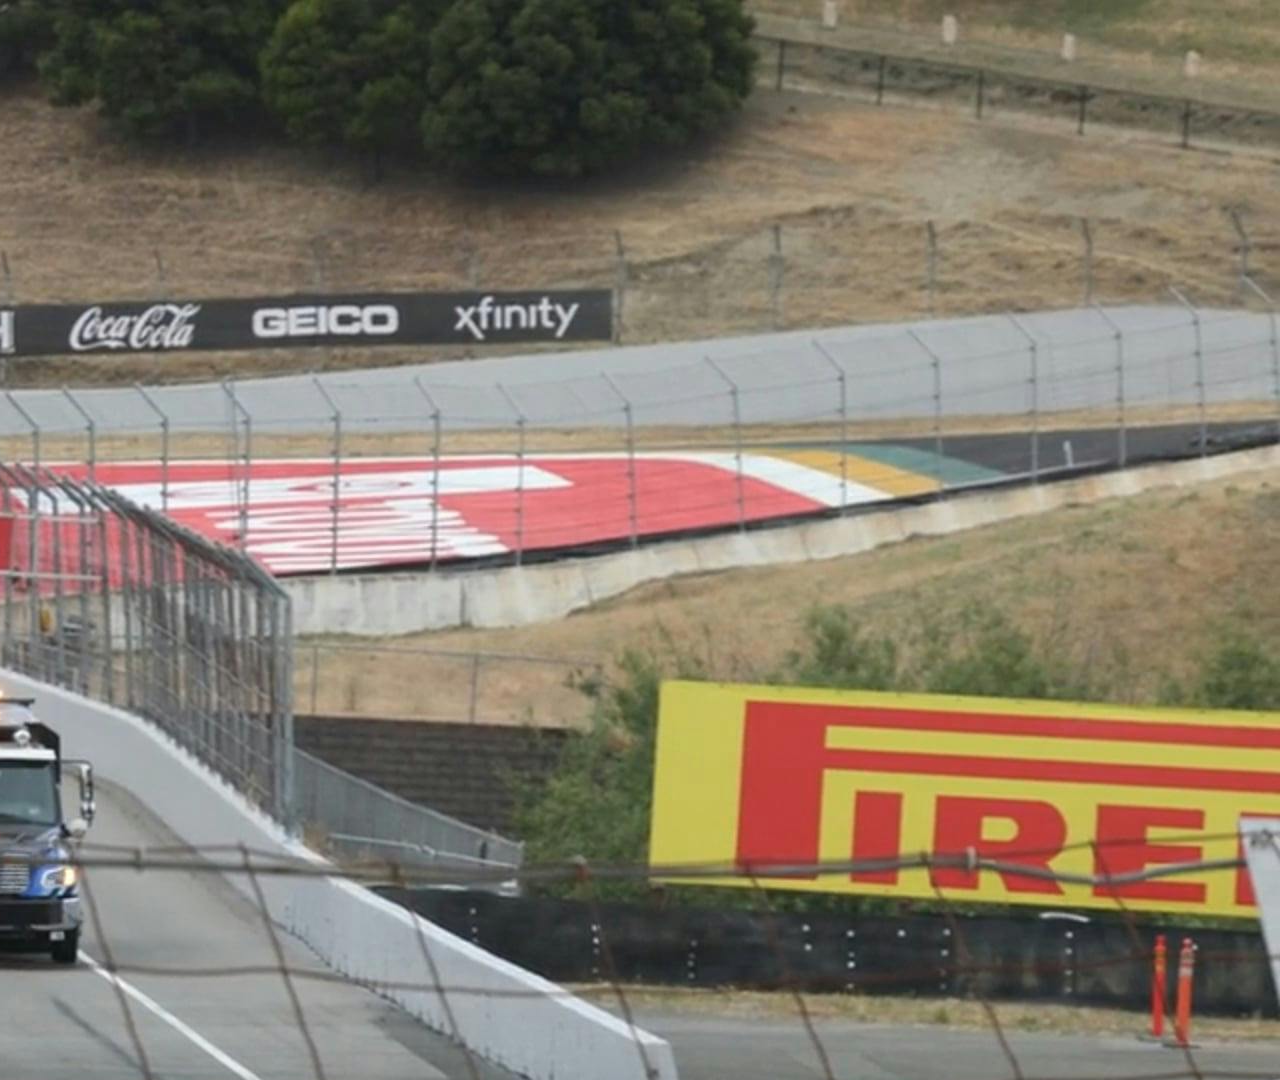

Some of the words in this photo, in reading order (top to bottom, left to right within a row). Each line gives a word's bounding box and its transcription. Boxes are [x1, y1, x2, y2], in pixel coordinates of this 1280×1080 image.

[252, 305, 399, 338] GEICO
[453, 295, 580, 341] xfinity
[734, 699, 1280, 907] PIRE
